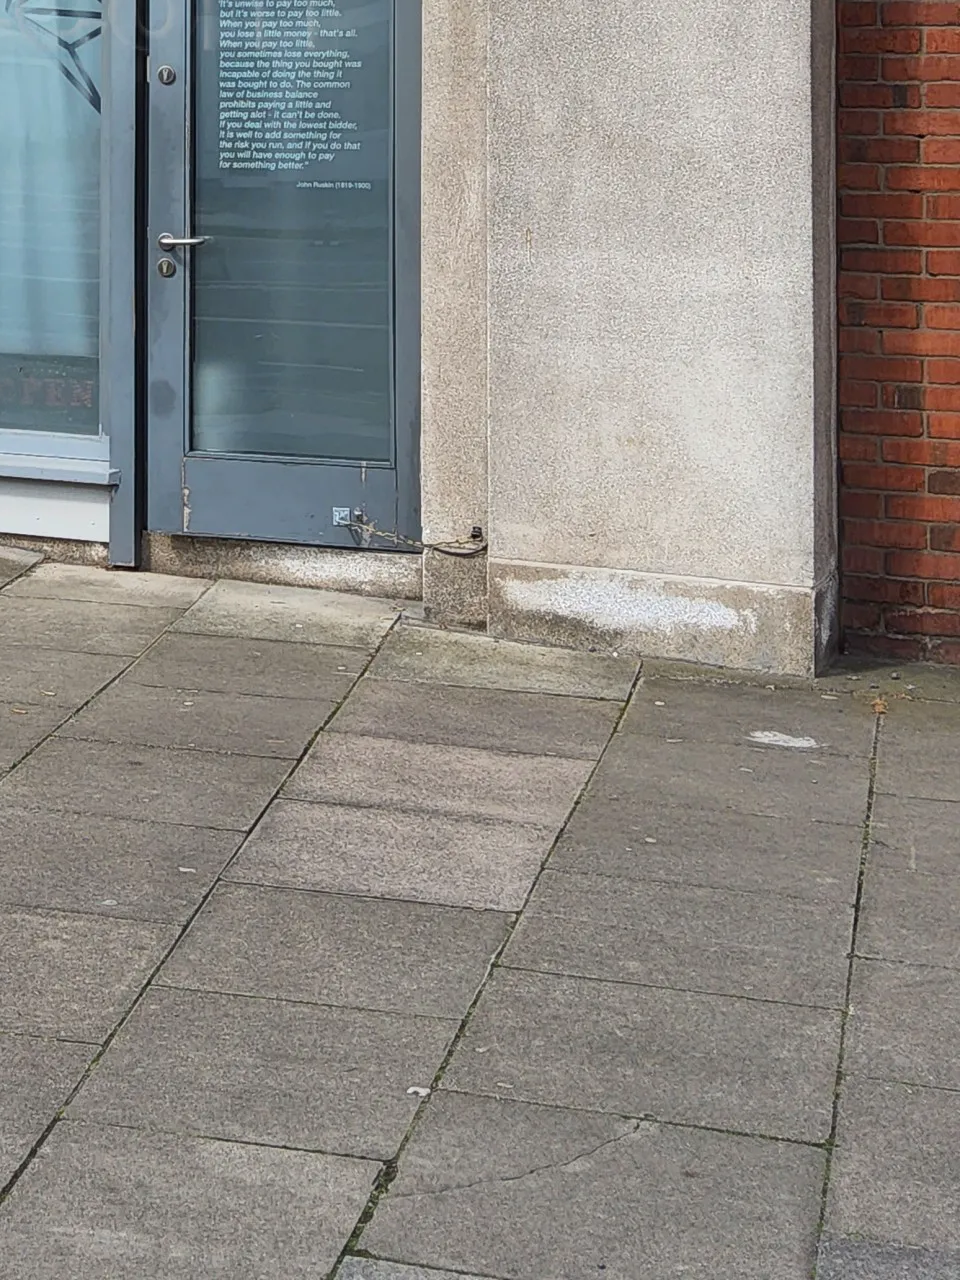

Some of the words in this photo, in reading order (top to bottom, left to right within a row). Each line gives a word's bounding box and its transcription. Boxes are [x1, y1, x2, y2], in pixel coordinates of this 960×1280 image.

[276, 1, 290, 9] pay
[220, 9, 233, 17] but
[236, 9, 248, 17] it's
[288, 10, 303, 18] pay
[306, 9, 319, 17] too
[220, 31, 235, 39] you
[320, 29, 343, 37] that's
[220, 40, 242, 48] When
[262, 41, 277, 49] pay
[257, 60, 269, 68] the
[272, 60, 292, 69] thing
[313, 60, 342, 68] bought
[220, 70, 259, 79] incapable
[272, 70, 295, 79] doing
[314, 70, 334, 79] thing
[238, 80, 268, 89] bought
[220, 101, 255, 109] prohibits
[258, 101, 285, 109] paying
[220, 111, 248, 119] getting
[329, 122, 357, 130] bidder,
[283, 132, 327, 140] something
[275, 152, 306, 160] enough
[318, 153, 335, 161] pay
[232, 161, 276, 170] something
